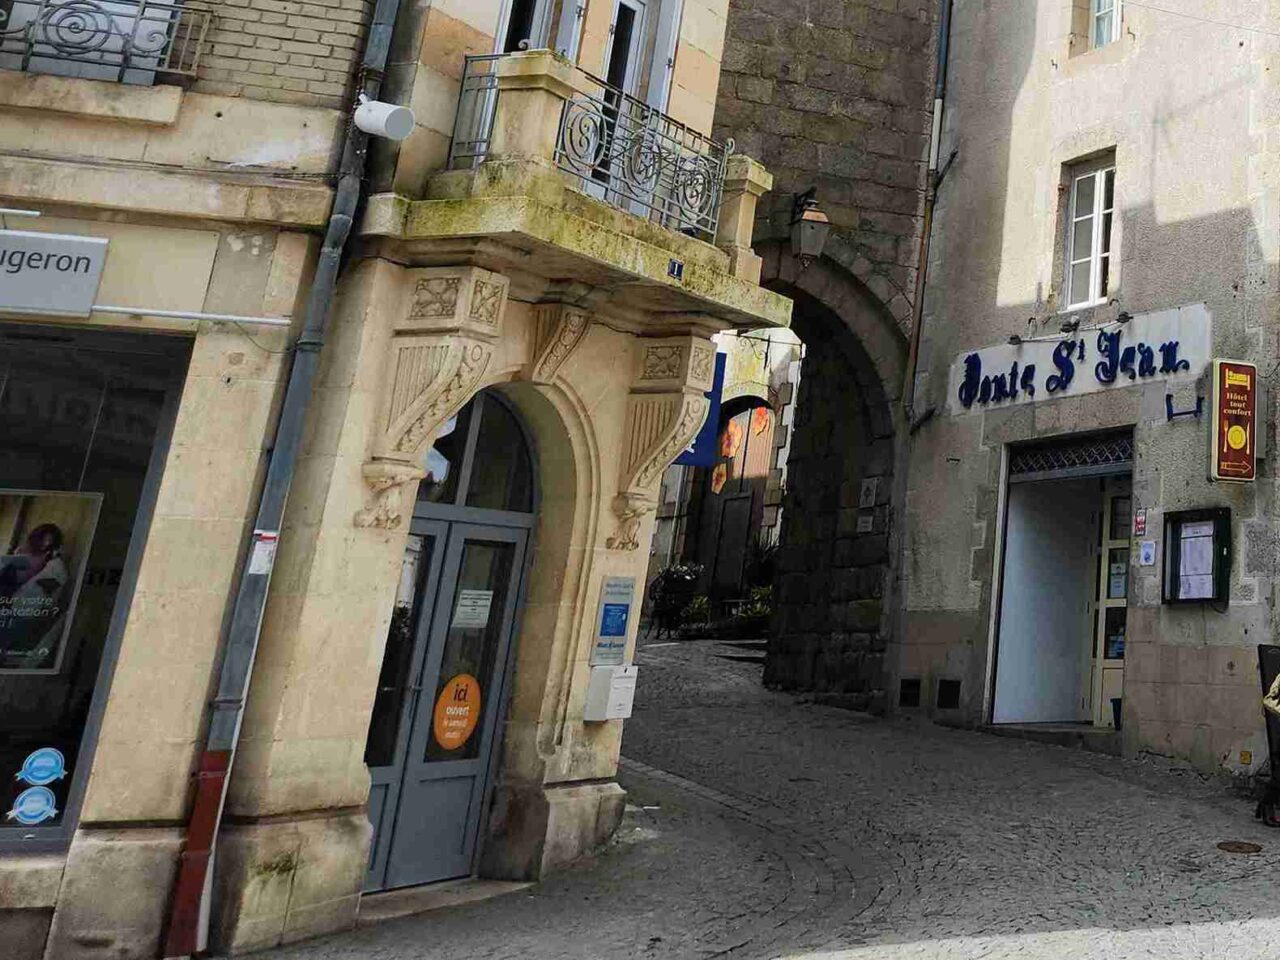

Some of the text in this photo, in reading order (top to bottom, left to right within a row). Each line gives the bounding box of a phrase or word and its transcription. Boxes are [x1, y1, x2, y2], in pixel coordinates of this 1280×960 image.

[1094, 327, 1191, 384] Jean
[1226, 392, 1248, 401] Hôtel
[1223, 408, 1252, 417] confort
[454, 683, 469, 701] ici
[446, 705, 470, 716] ouvert
